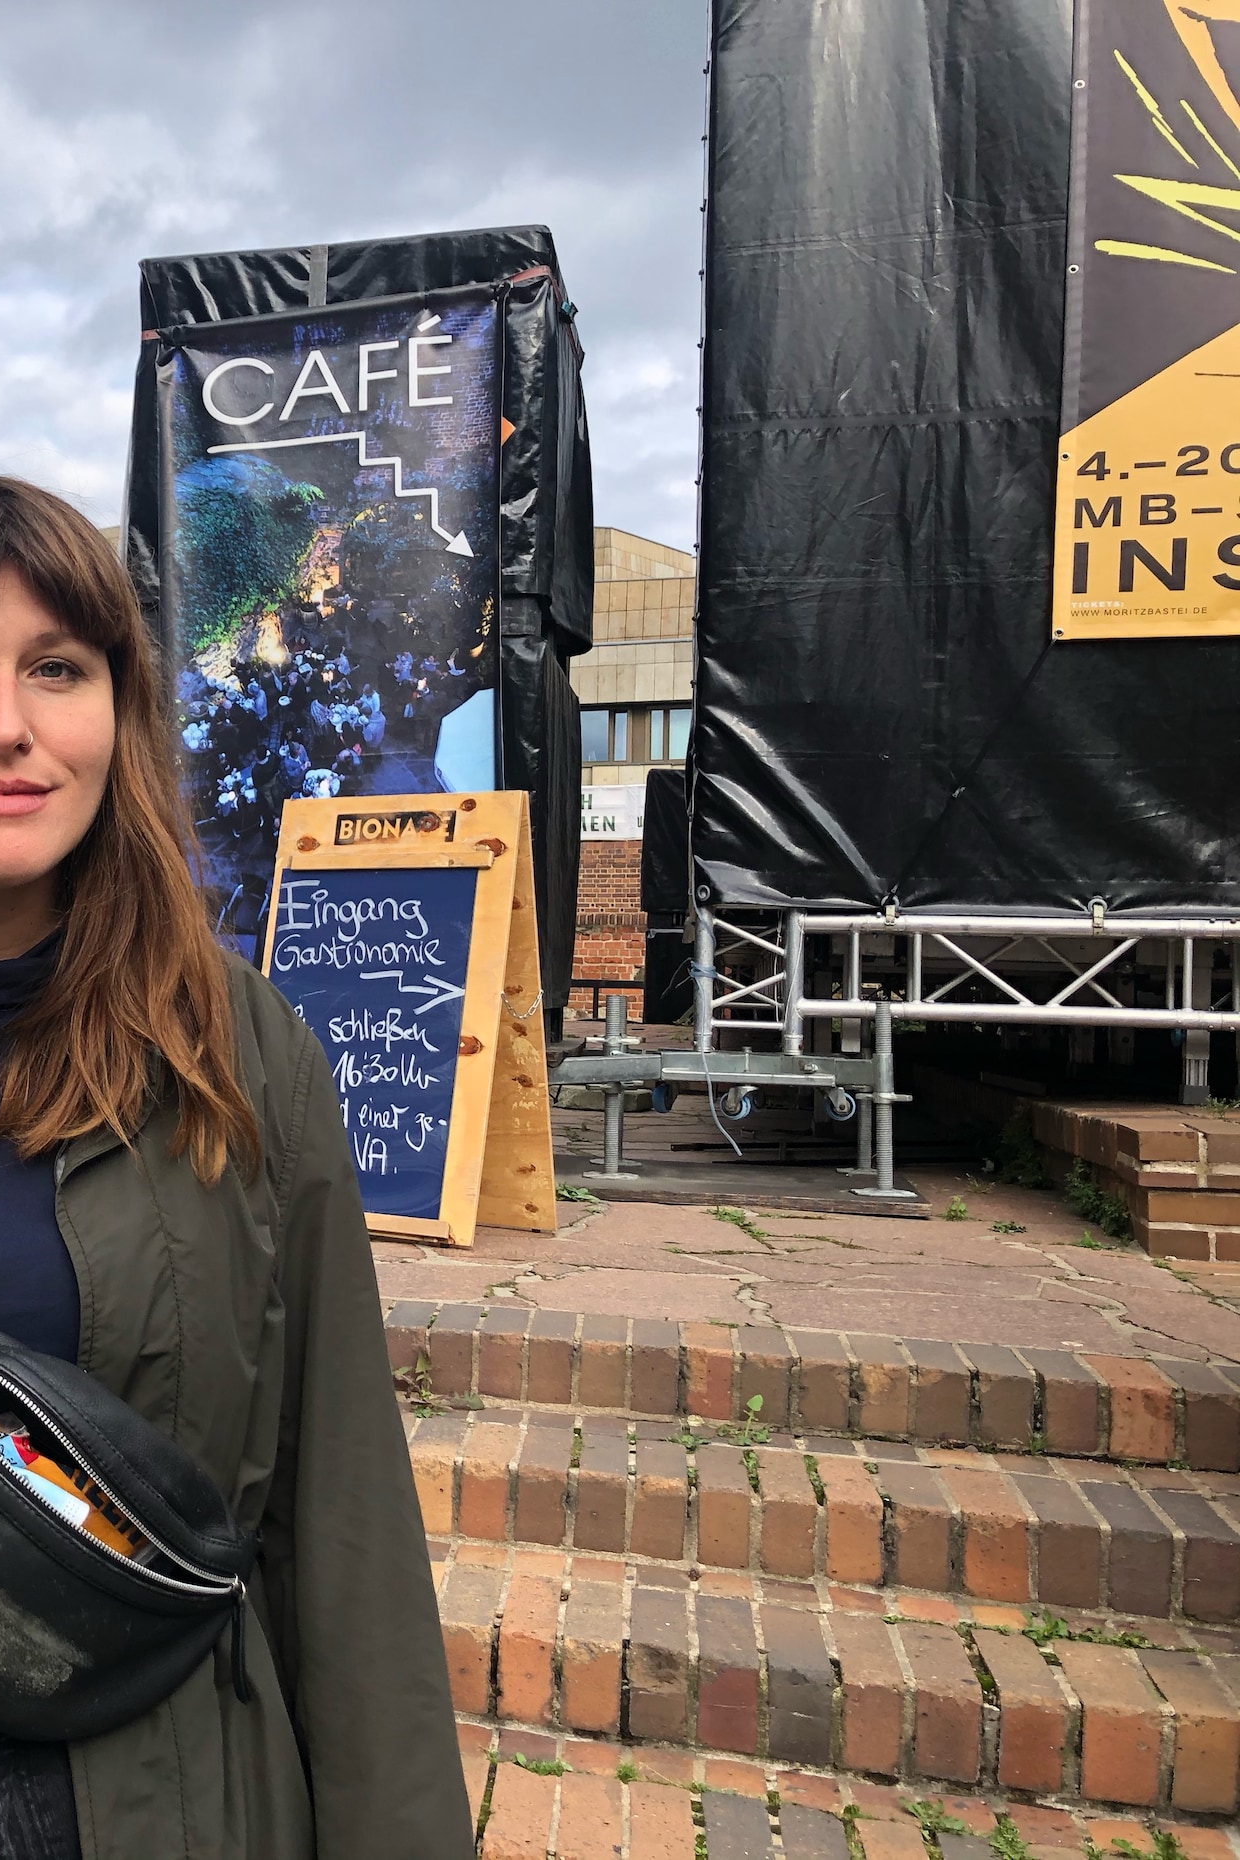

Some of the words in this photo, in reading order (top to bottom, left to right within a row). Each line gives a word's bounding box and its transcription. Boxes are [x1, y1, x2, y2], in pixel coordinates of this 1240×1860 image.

[202, 314, 454, 426] CAFÉ
[1074, 493, 1240, 529] MB-
[1071, 600, 1125, 609] TICKETS:
[338, 811, 451, 841] BIONAE
[276, 879, 429, 943] Eingang
[274, 933, 447, 972] Gastronomie
[358, 1097, 410, 1130] einer
